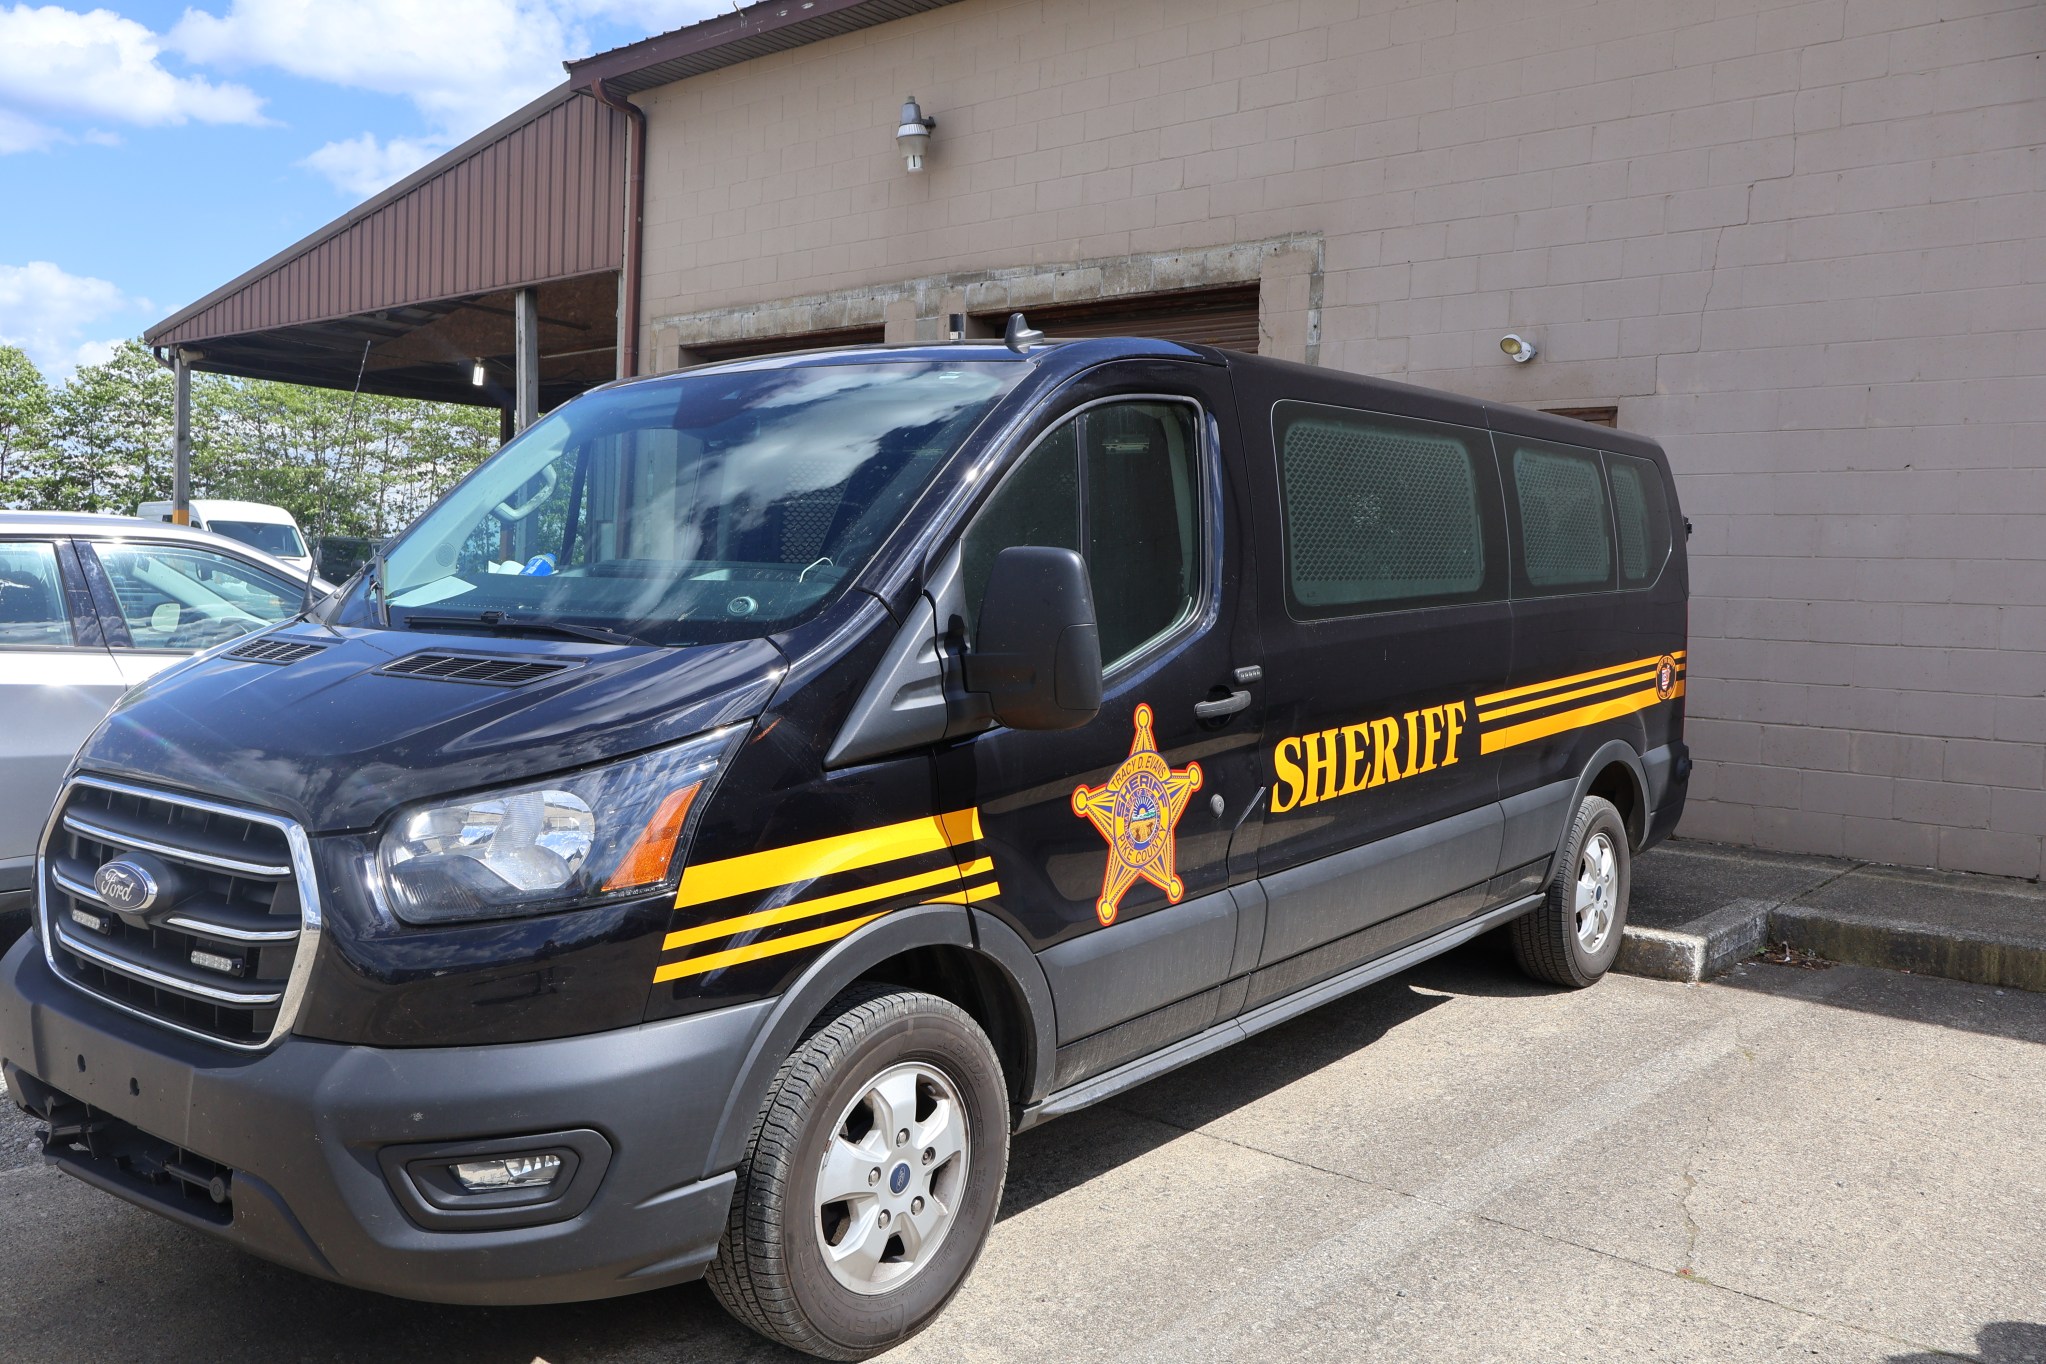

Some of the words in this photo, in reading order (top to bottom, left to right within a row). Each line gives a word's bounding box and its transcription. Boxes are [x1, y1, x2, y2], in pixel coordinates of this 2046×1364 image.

[1111, 759, 1136, 789] TRACY
[1138, 757, 1144, 769] D.
[1145, 755, 1167, 779] EVANS
[1270, 700, 1467, 813] SHERIFF
[1116, 774, 1168, 818] SHERIFF
[1118, 833, 1132, 861] PIKE
[1135, 825, 1167, 863] COUNTY
[101, 869, 134, 902] Ford
